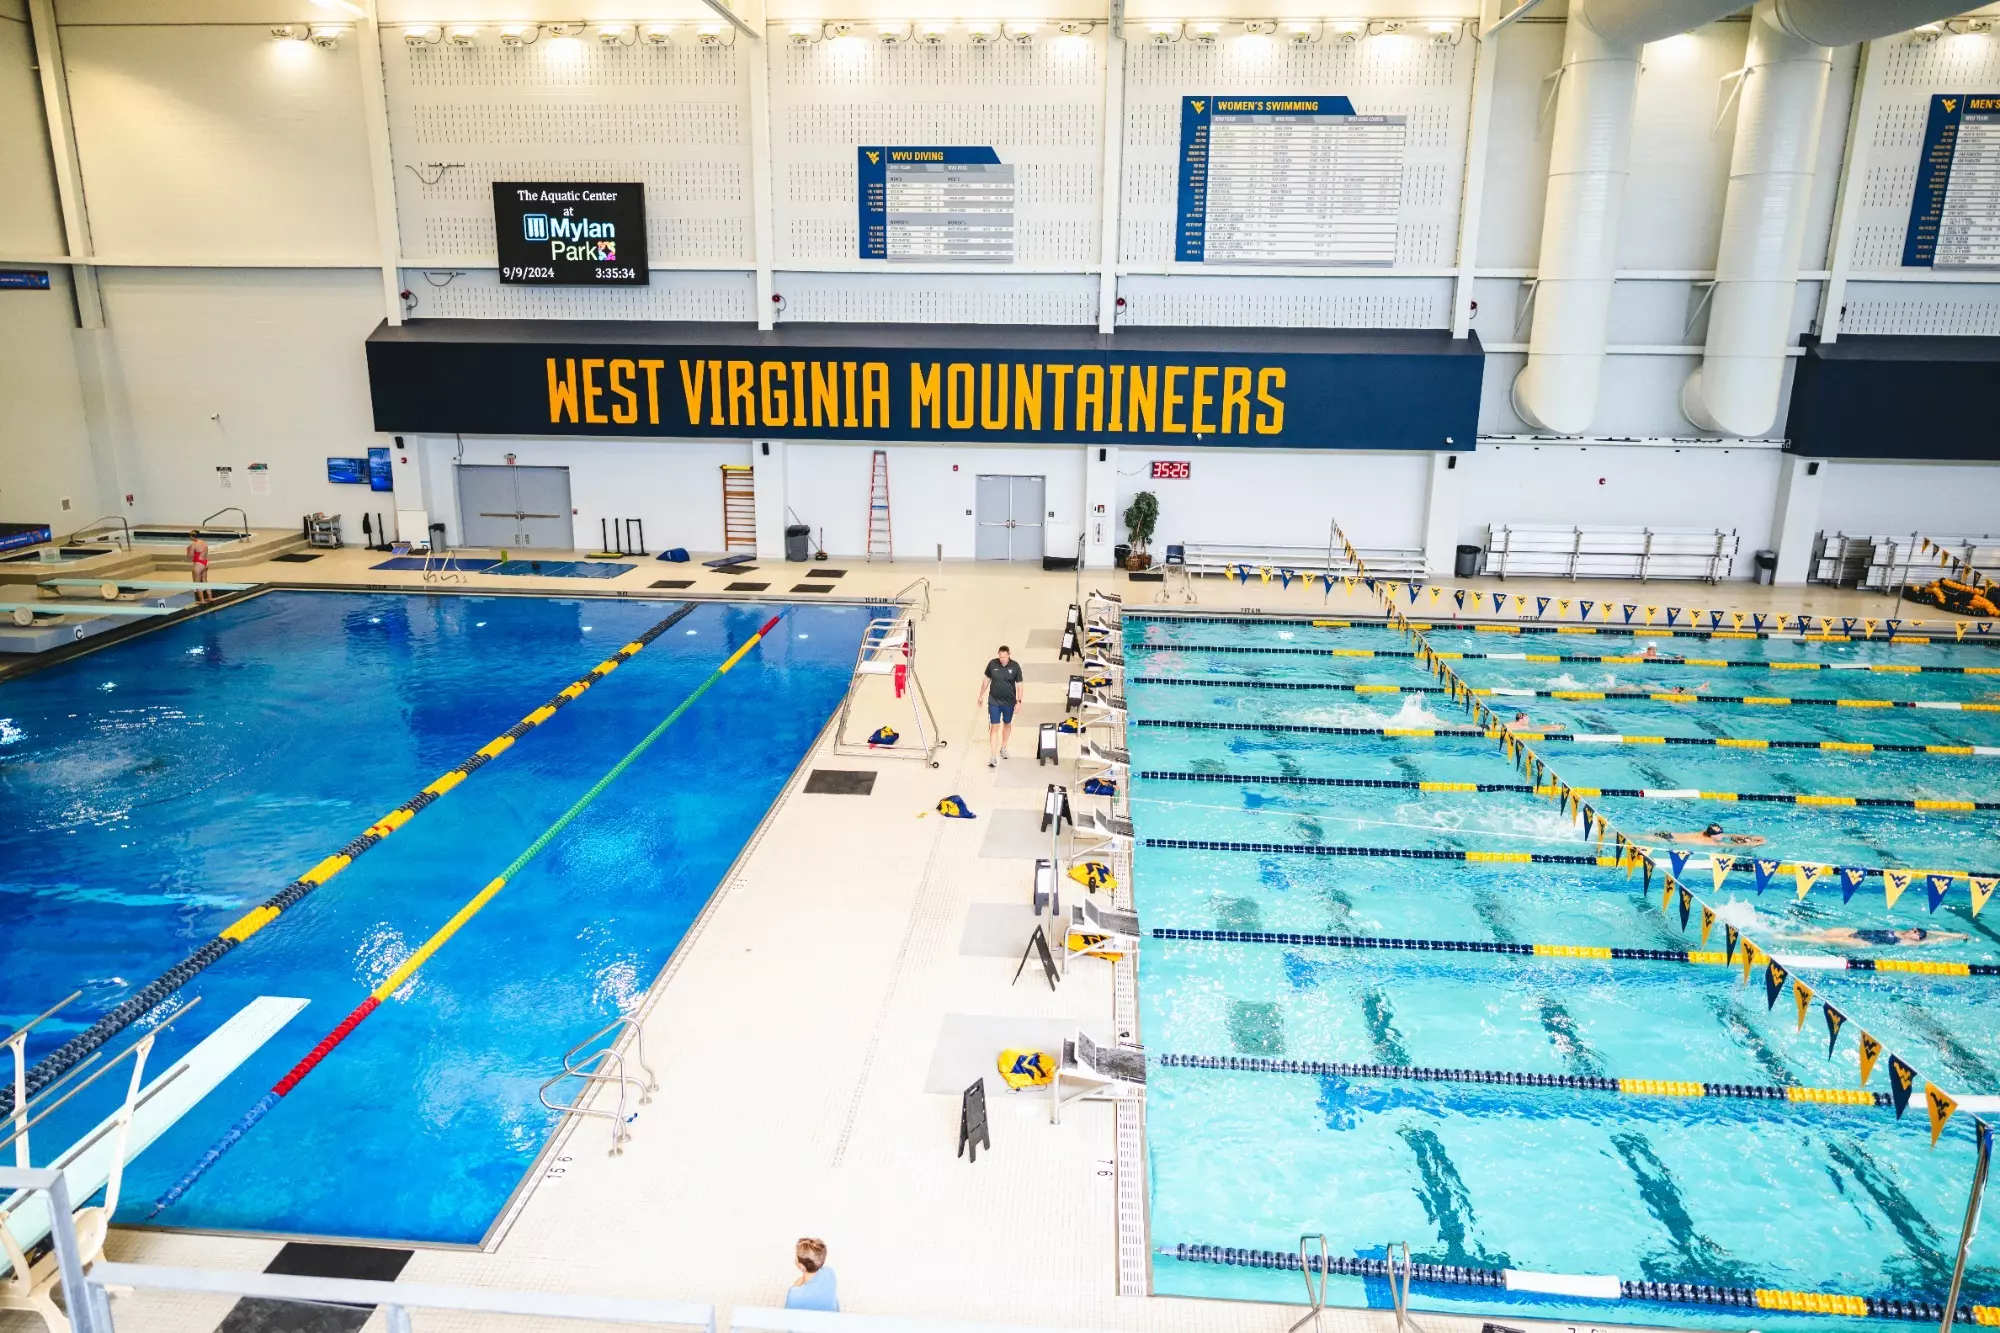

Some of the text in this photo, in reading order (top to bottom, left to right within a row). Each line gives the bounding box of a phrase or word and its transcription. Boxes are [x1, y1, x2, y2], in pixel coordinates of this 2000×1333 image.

[1217, 101, 1319, 111] WOMEN'S SWIMMING
[892, 151, 944, 161] WVU DIVING
[517, 190, 617, 203] The Aquatic Center
[563, 206, 574, 216] at
[550, 217, 616, 242] Mylan
[551, 240, 598, 261] Park
[503, 267, 554, 280] 9/9/2024
[595, 267, 636, 279] 3:35:34
[546, 358, 1287, 435] WEST VIRGINIA MOUNTAINEERS
[1153, 462, 1189, 478] 35:26
